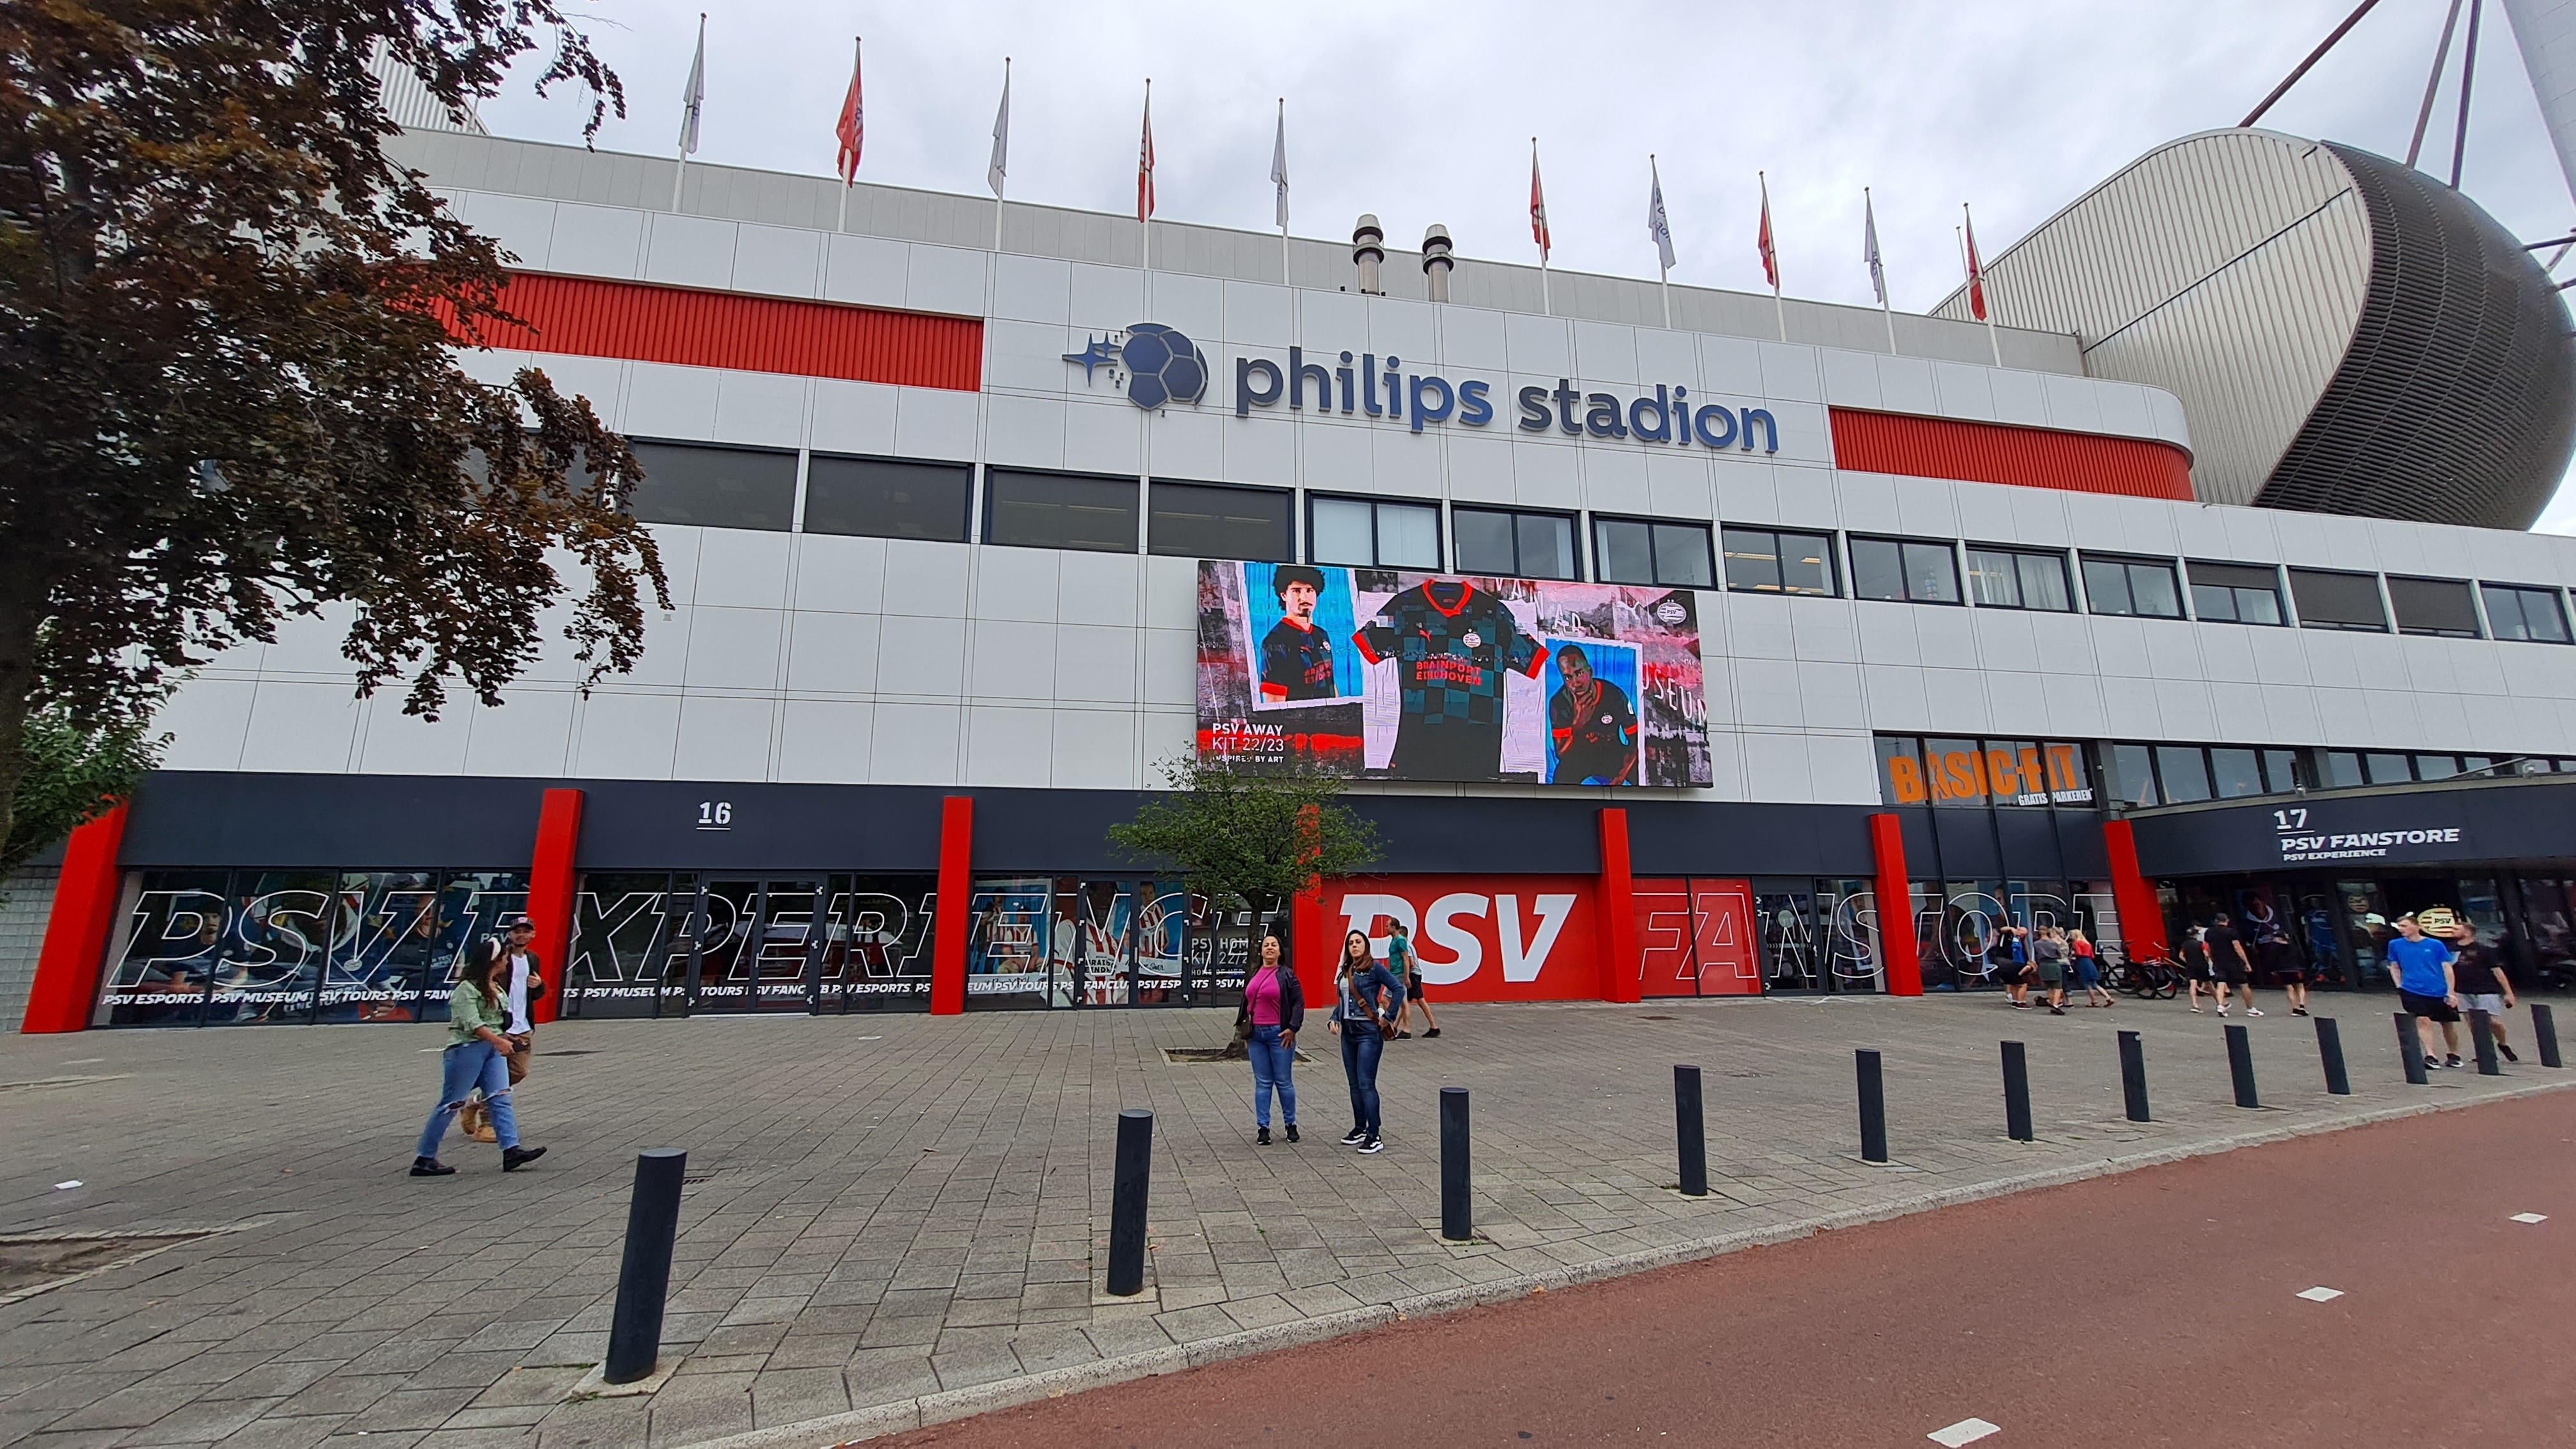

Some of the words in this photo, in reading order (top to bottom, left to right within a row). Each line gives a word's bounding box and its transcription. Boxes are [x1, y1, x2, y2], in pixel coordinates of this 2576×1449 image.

[1236, 345, 1494, 434] philips
[1518, 378, 1779, 454] stadion
[1416, 661, 1481, 675] BRAINPORT
[1416, 671, 1481, 686] EINDHOVEN
[1213, 723, 1239, 735] PSV
[1243, 724, 1284, 737] AWAY
[1213, 737, 1237, 751] KIT
[1243, 738, 1284, 753] 22/23
[1888, 745, 2078, 804] BASIC-FIT
[2018, 793, 2048, 806] GRATIS
[698, 802, 732, 824] 16
[2273, 808, 2307, 829] 17
[2281, 836, 2326, 851] PSV
[2329, 828, 2460, 848] FANSTORE
[2308, 848, 2386, 860] EXPERIENCE
[106, 890, 437, 988] PSV
[1220, 938, 1248, 949] HOM
[1333, 893, 1577, 985] PSV
[1219, 951, 1247, 965] 22/2
[583, 988, 612, 997] PSV
[700, 986, 743, 995] TOURS
[857, 984, 910, 993] ESPORTS
[915, 983, 931, 992] PS
[994, 981, 1017, 991] PSV
[1060, 981, 1075, 990] PS
[1084, 981, 1129, 990] FANCLU
[1138, 980, 1160, 988] PSV
[1216, 979, 1235, 988] PSV
[102, 994, 134, 1005] PSV
[135, 993, 204, 1004] ESPORTS
[210, 992, 245, 1004] PSV
[243, 991, 309, 1003] MUSEUM
[342, 991, 388, 1001] TOURS
[392, 990, 420, 1000] PSV
